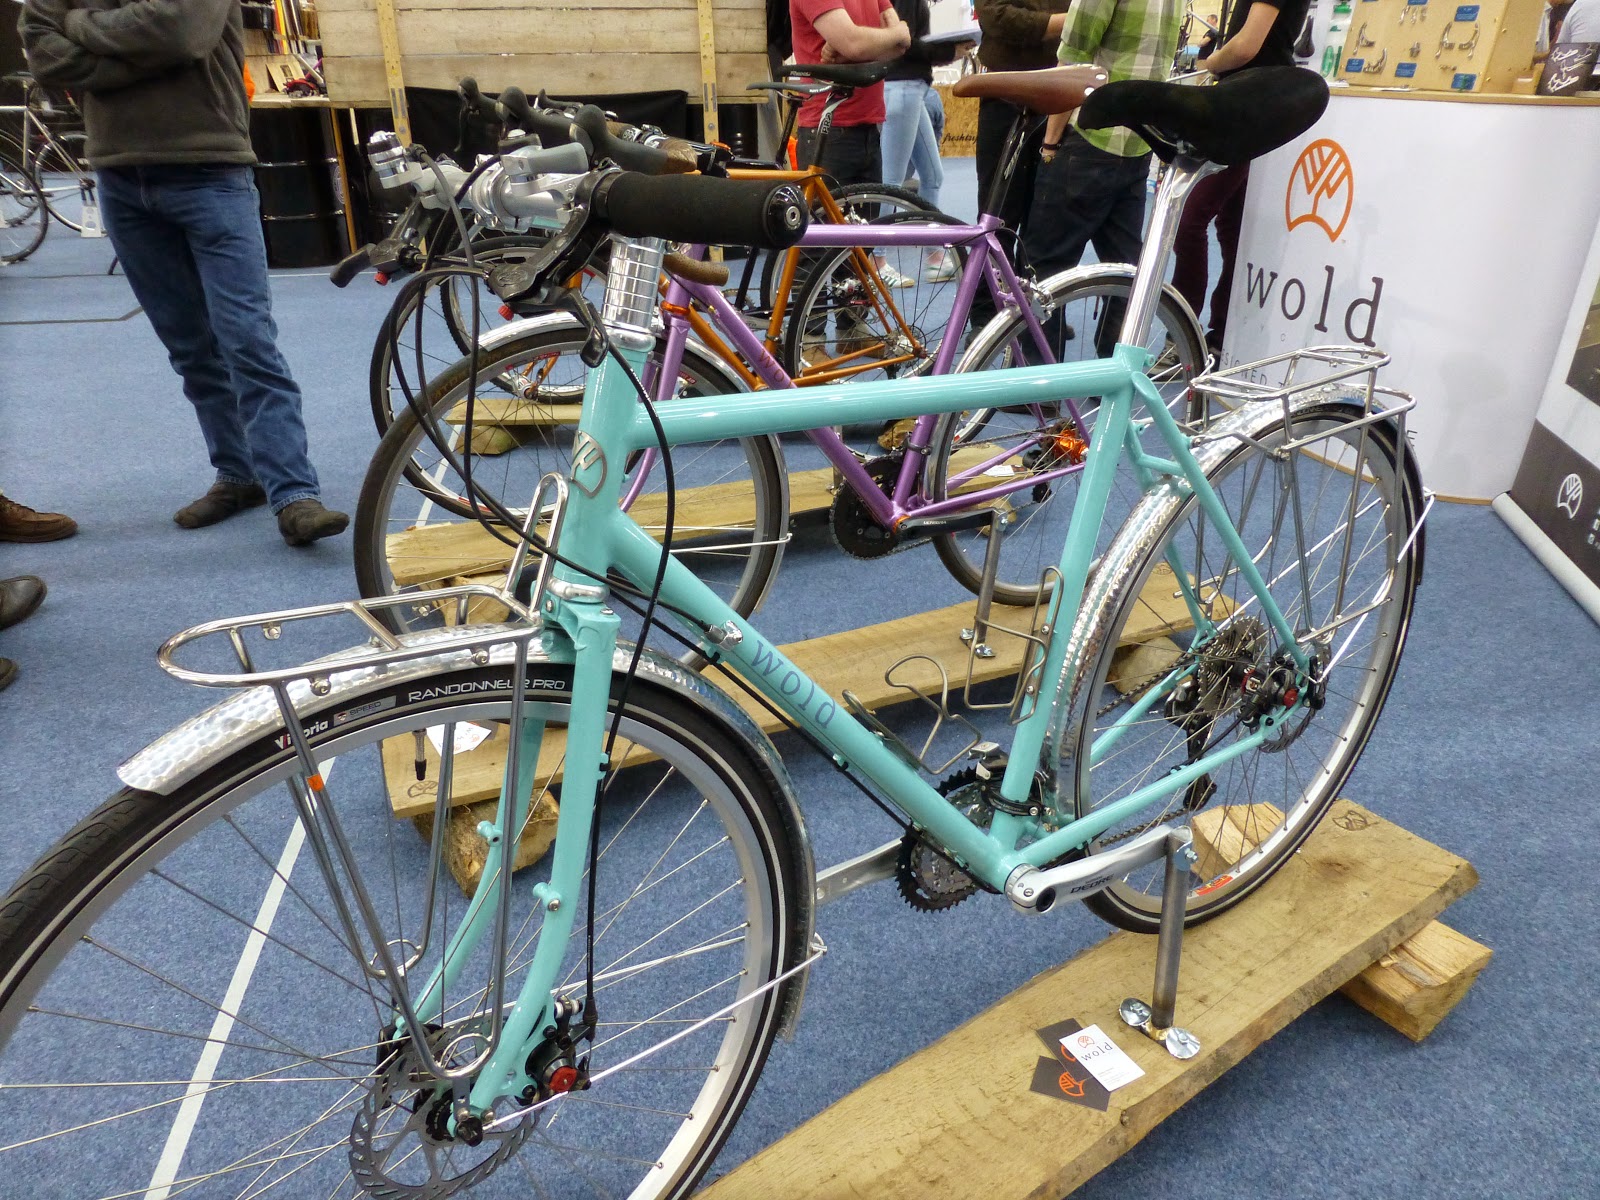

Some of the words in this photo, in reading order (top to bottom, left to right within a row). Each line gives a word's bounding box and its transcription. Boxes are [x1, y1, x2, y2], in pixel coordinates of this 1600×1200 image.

[1247, 262, 1384, 348] wold
[532, 679, 566, 690] PRO
[751, 639, 836, 729] wold
[349, 701, 382, 716] SPEED
[275, 720, 329, 750] Vioria
[1070, 873, 1114, 894] DEORE
[1081, 1041, 1114, 1061] wold
